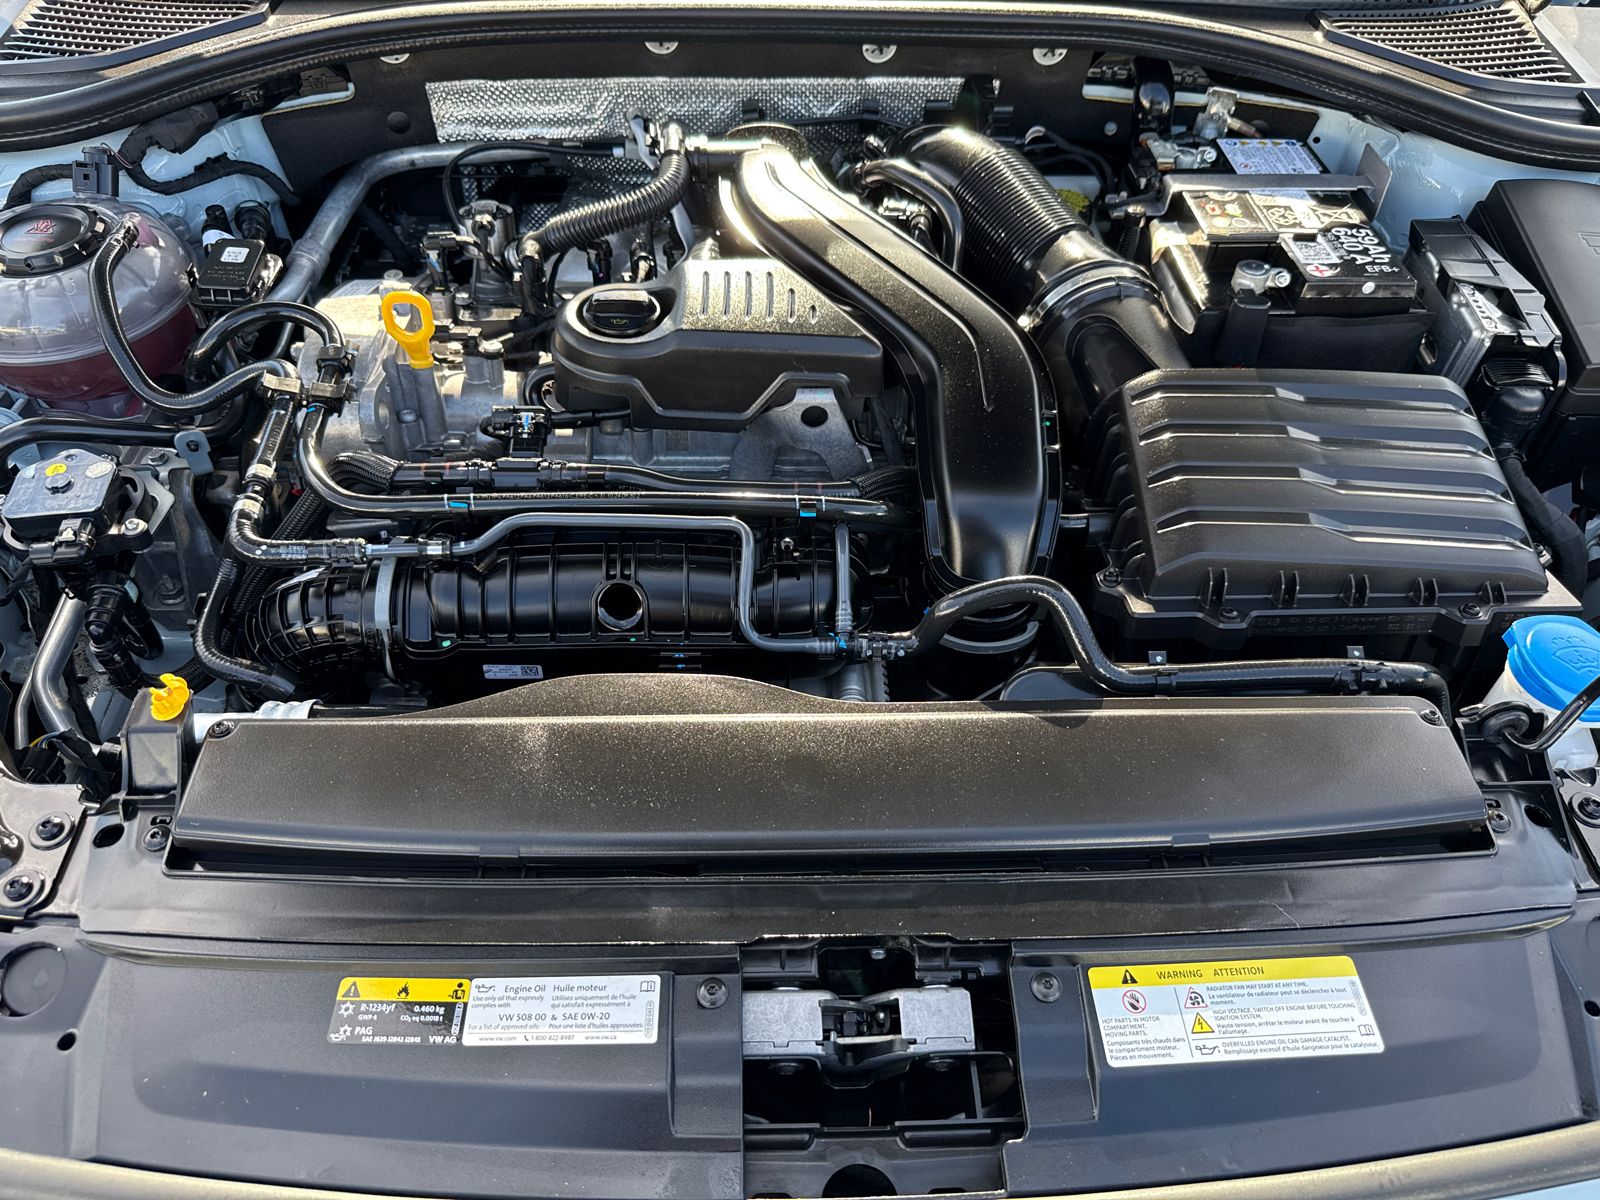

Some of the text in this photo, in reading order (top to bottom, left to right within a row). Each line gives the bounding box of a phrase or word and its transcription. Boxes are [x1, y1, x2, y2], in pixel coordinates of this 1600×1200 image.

[1331, 227, 1363, 251] 640
[1350, 253, 1373, 265] A
[1352, 227, 1391, 263] 59Ah
[1364, 265, 1400, 274] EFB+
[1156, 966, 1264, 980] WARNING ATTENTION
[504, 985, 532, 994] Engine
[361, 1003, 396, 1013] R-1234yf
[436, 1005, 445, 1014] kg
